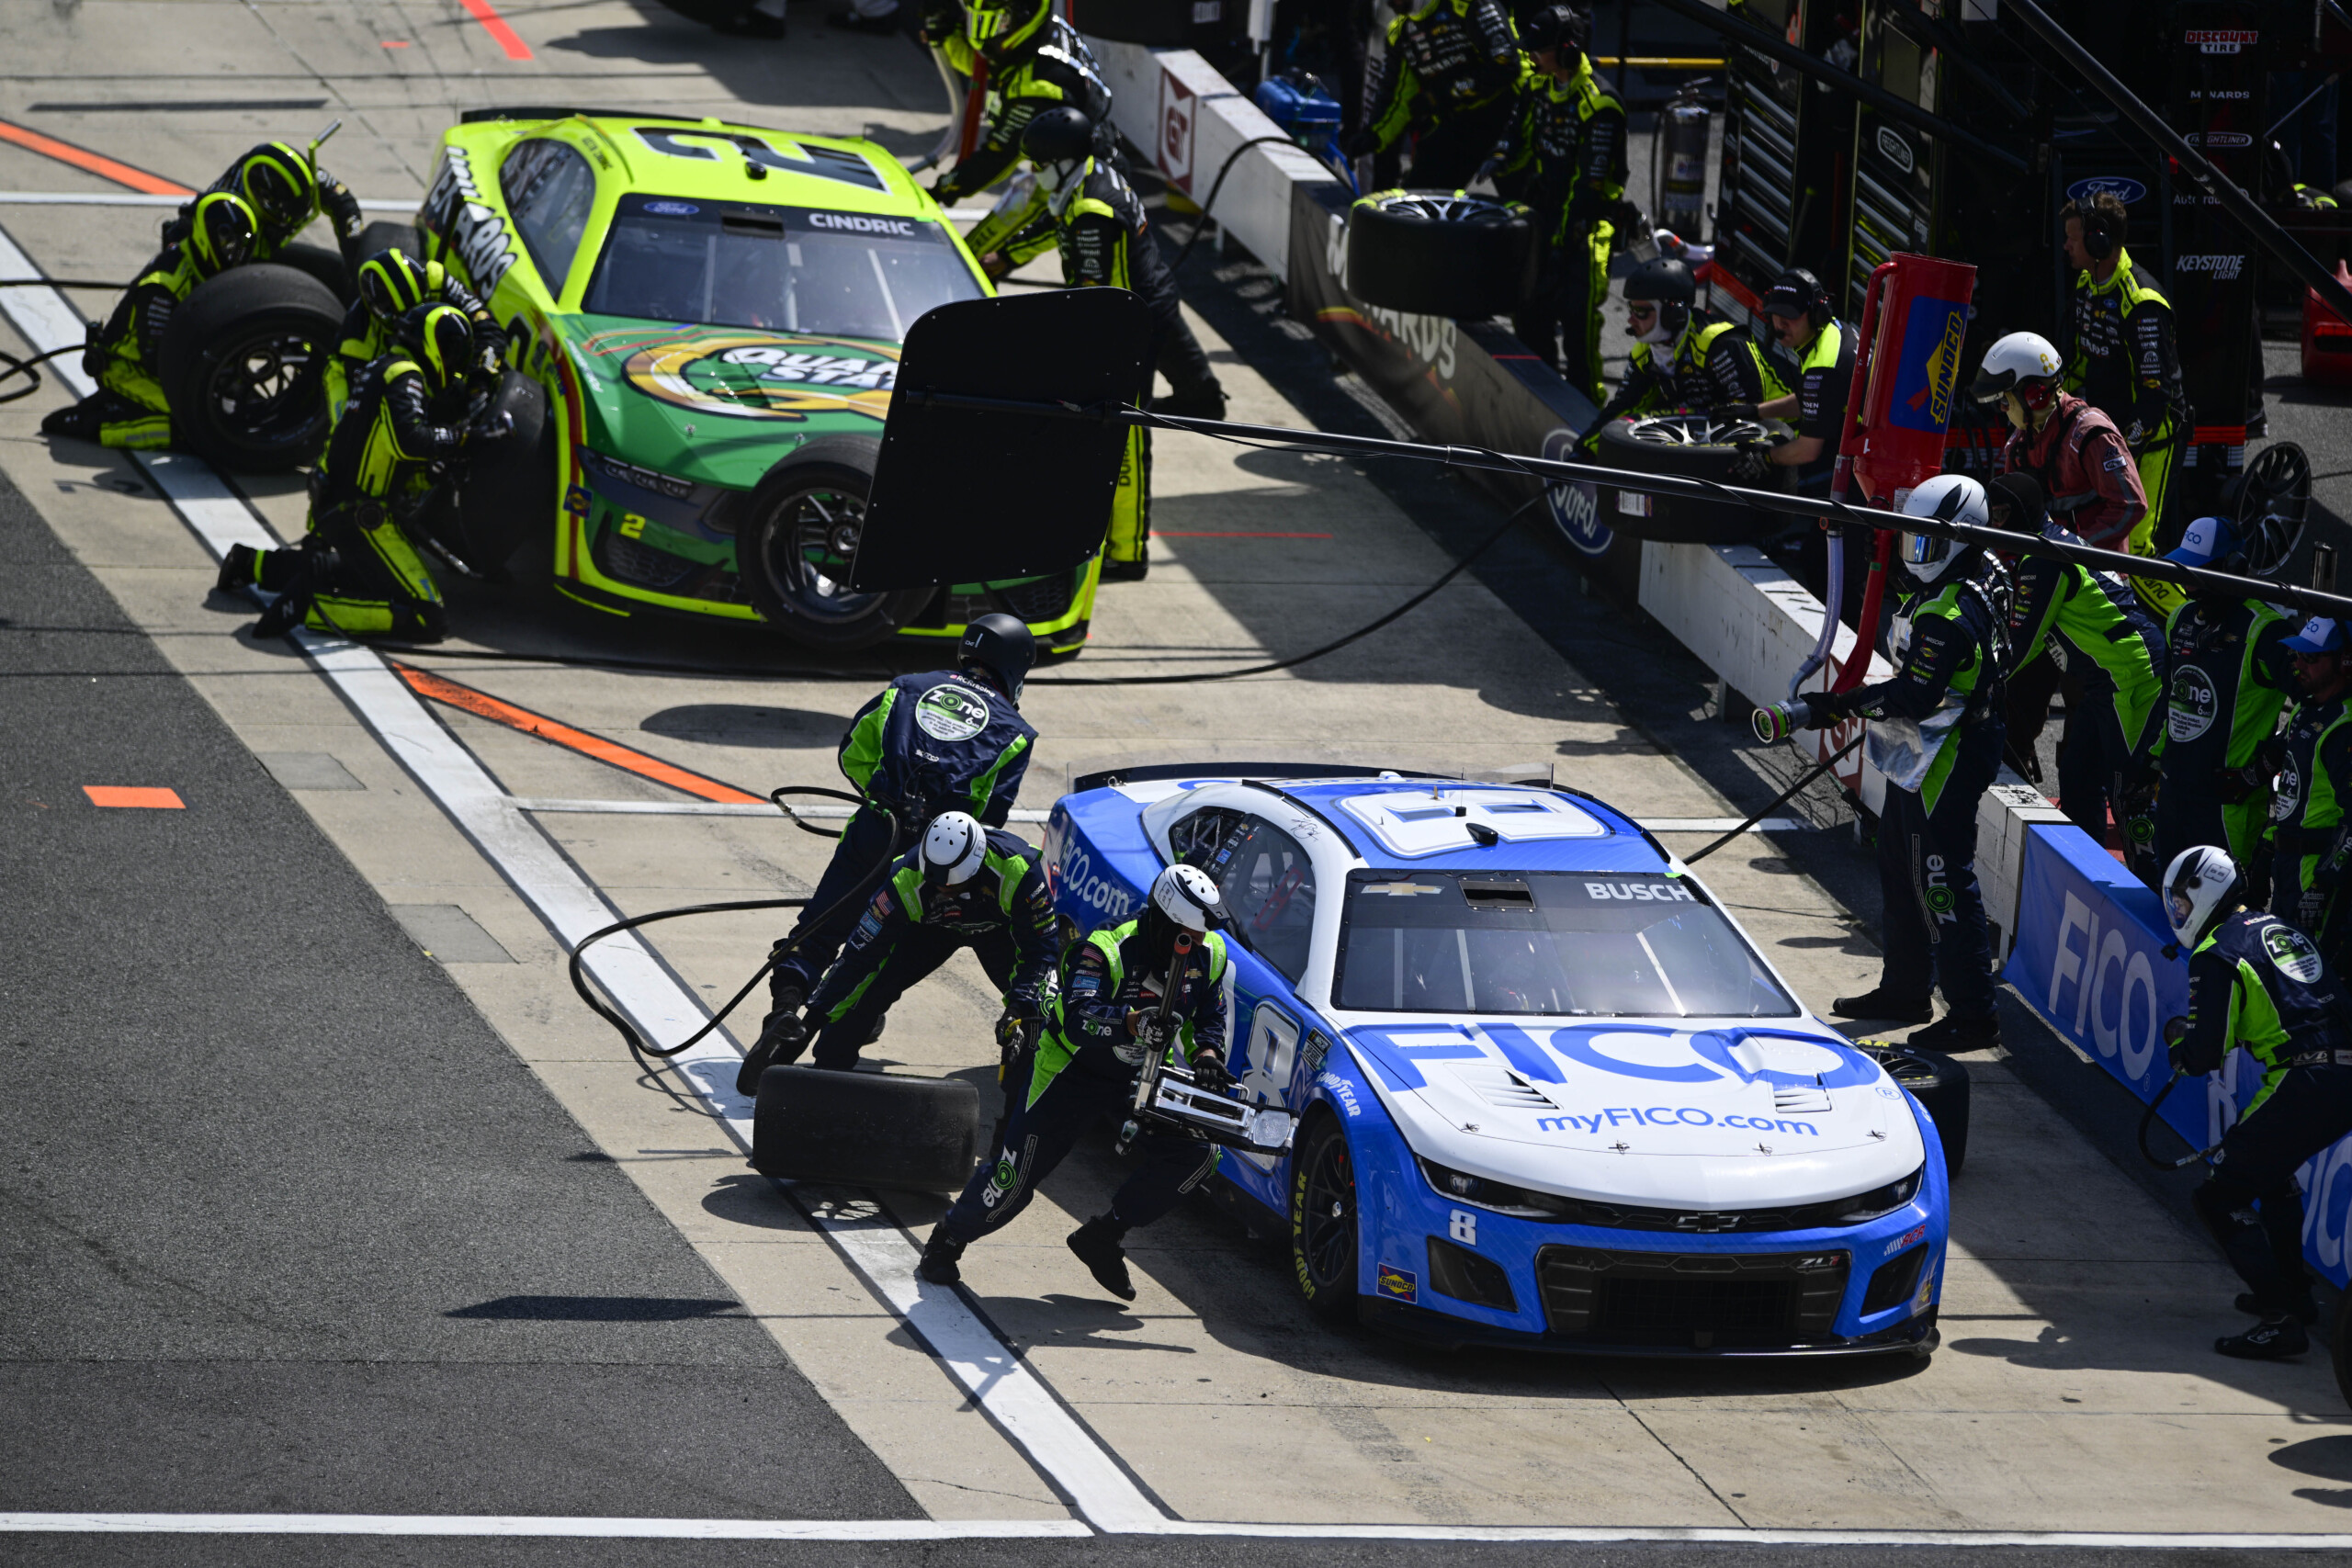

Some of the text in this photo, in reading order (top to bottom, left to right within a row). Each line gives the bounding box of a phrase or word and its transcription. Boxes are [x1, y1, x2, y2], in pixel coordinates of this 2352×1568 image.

[2185, 29, 2258, 44] DISCOUNT
[2205, 43, 2236, 52] TIRE
[2190, 90, 2250, 99] MNARDS
[2189, 136, 2247, 144] FRGHTLINER
[808, 211, 917, 237] CINDRIC
[2176, 254, 2245, 273] KEYSTONE
[2212, 269, 2241, 280] LIGHT
[1931, 314, 1963, 421] SUNOCO
[618, 513, 647, 540] 2
[2306, 620, 2320, 633] CO
[928, 689, 986, 719] zone
[1584, 882, 1696, 904] BUSCH
[1925, 853, 1959, 925] zone
[2267, 932, 2305, 953] zone
[2048, 888, 2157, 1081] FICO
[1080, 1019, 1113, 1036] zone
[1340, 1021, 1880, 1092] FICO
[1316, 1071, 1362, 1118] GOODYEAR
[1536, 1106, 1819, 1136] myFICO.com
[982, 1145, 1018, 1208] zone
[1449, 1208, 1477, 1247] 8
[1796, 1255, 1841, 1269] ZL1
[1379, 1275, 1416, 1292] SUNOCO
